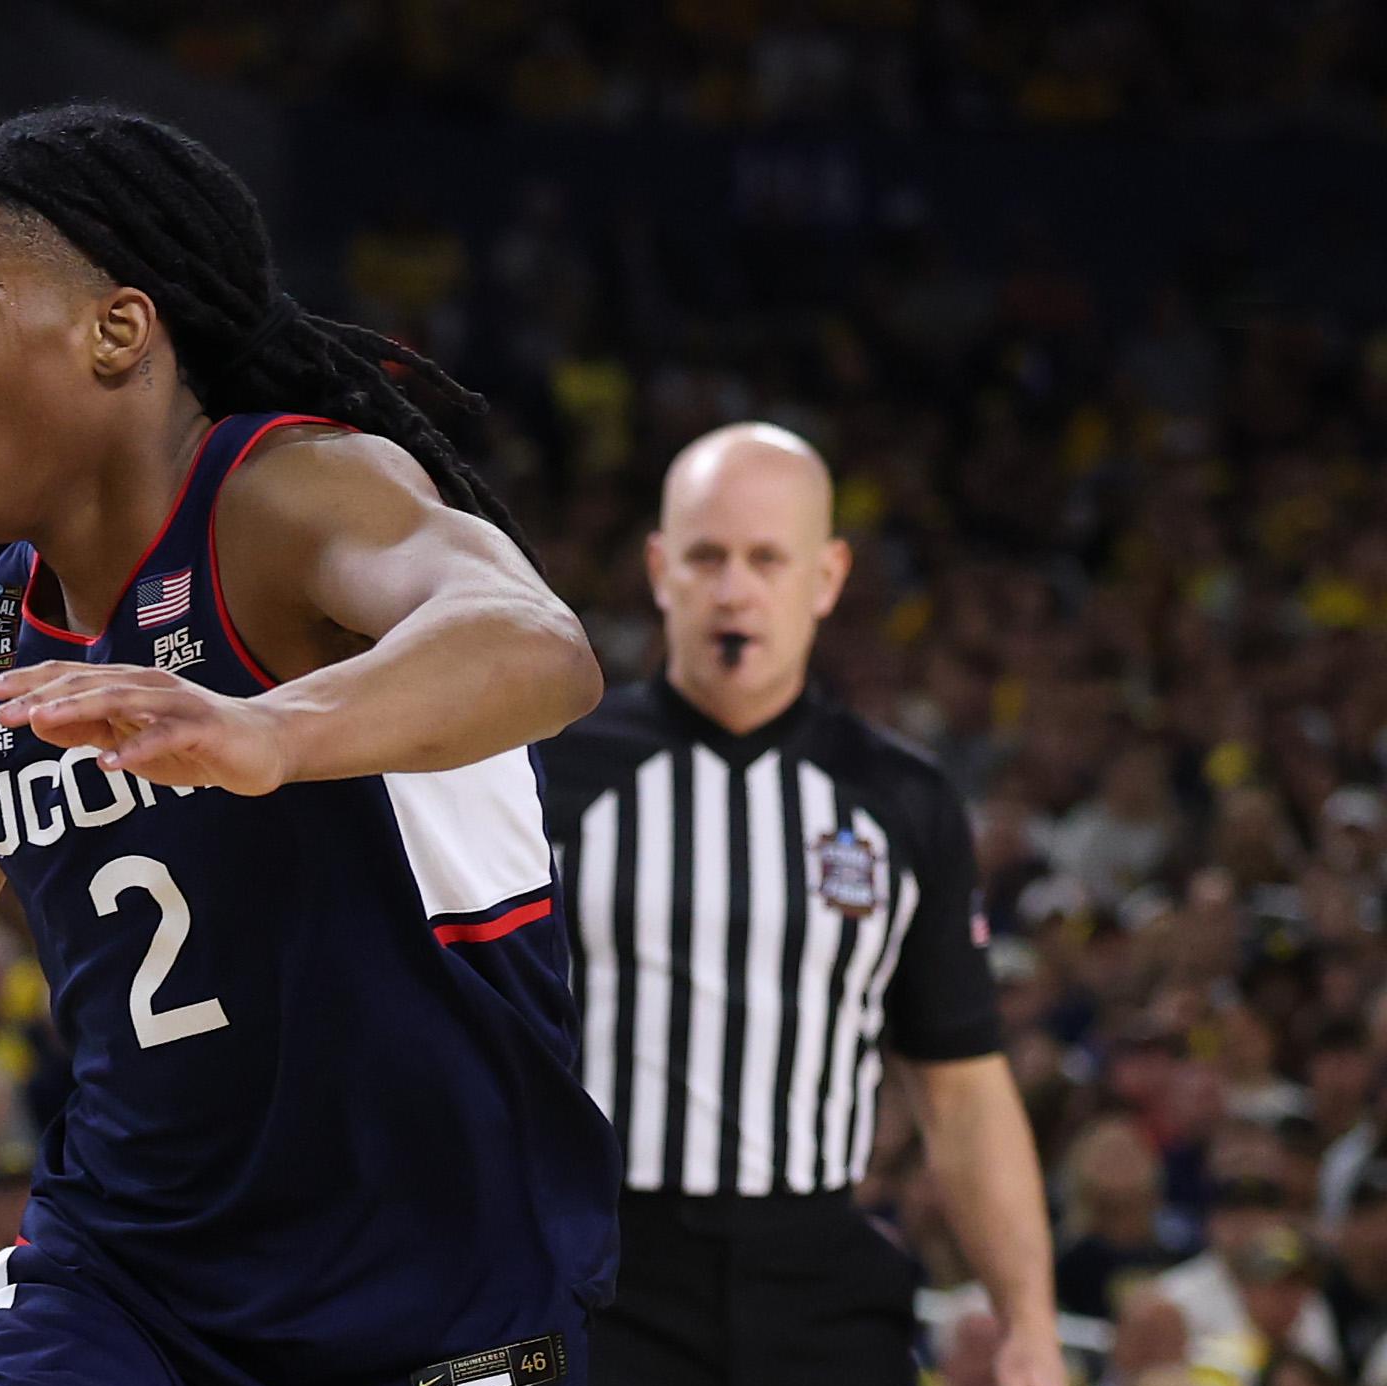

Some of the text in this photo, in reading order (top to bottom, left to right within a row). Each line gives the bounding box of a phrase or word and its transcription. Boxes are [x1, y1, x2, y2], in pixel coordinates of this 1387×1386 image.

[154, 626, 189, 656] BIG
[155, 640, 204, 671] EAST
[87, 855, 230, 1050] 2
[520, 1351, 547, 1374] 46
